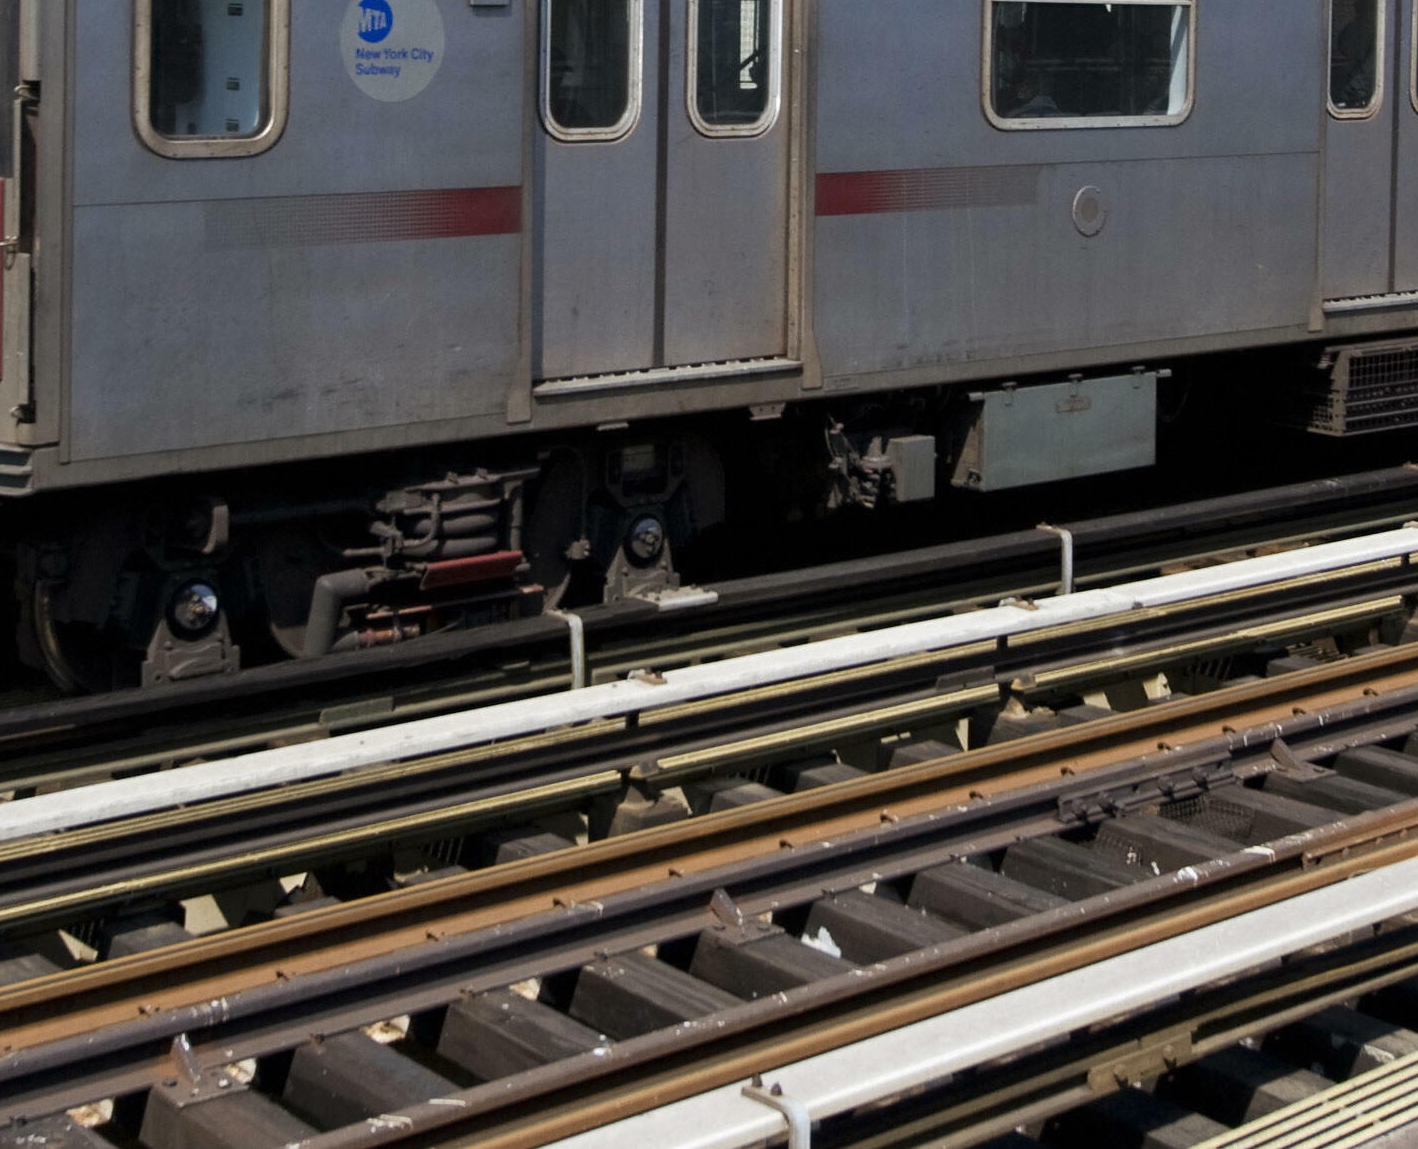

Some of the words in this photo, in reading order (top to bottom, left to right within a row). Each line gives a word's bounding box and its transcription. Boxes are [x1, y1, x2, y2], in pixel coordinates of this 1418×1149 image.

[358, 4, 386, 33] MTA
[355, 48, 381, 60] New
[384, 47, 409, 60] York
[411, 47, 435, 63] City
[355, 62, 401, 79] Subway
